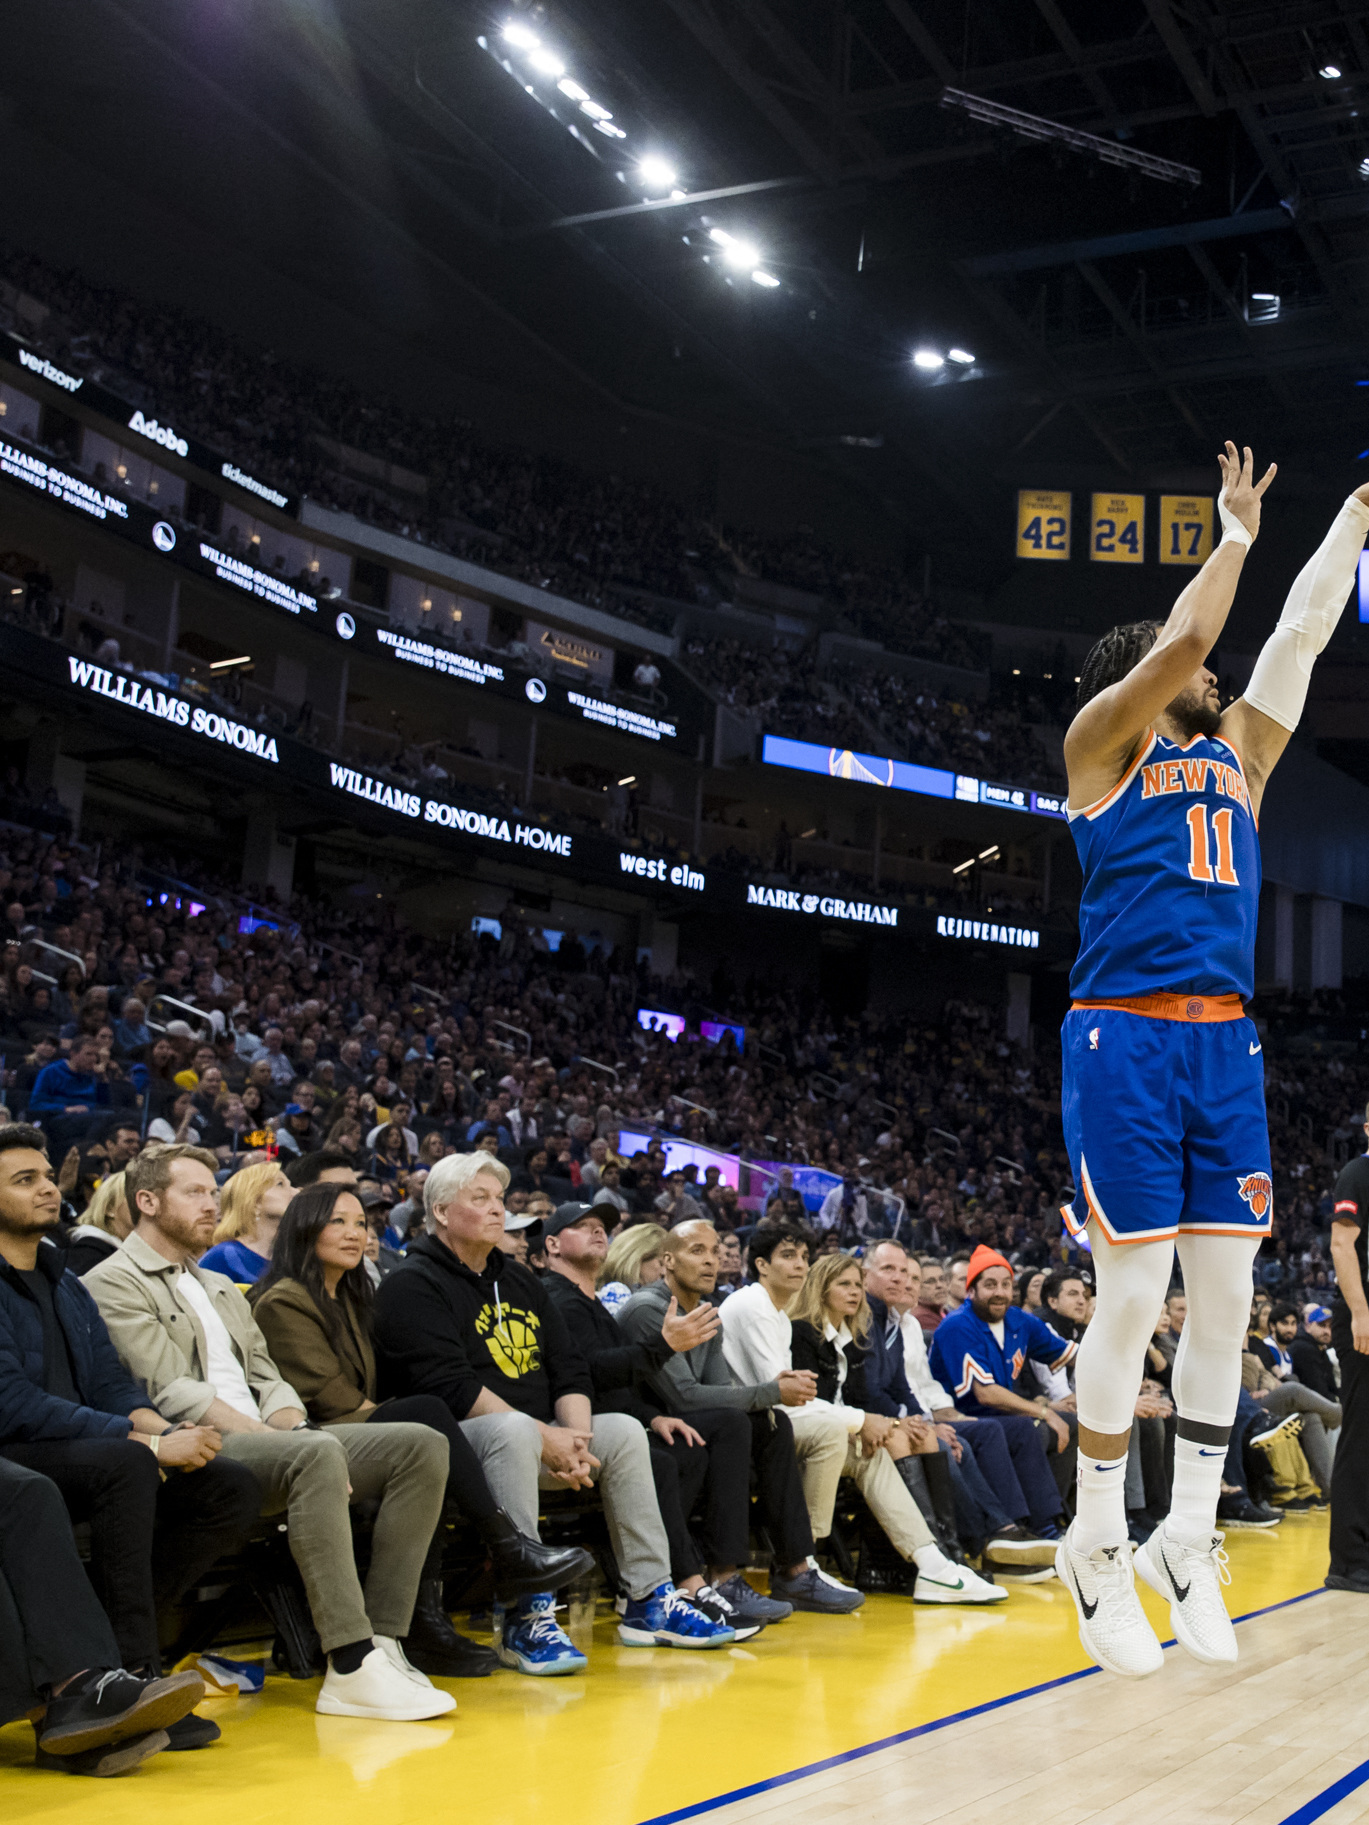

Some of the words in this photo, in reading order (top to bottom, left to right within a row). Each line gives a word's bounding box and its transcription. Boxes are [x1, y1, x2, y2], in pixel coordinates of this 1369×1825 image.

[19, 349, 79, 392] verizon
[128, 411, 188, 457] Adobe
[221, 462, 288, 508] ticketmaster
[1022, 516, 1066, 551] 42
[1095, 519, 1139, 554] 24
[1170, 522, 1204, 556] 17
[68, 656, 190, 727] WILLIAMS
[191, 708, 279, 764] SONOMA
[1141, 758, 1210, 800] NEW
[330, 763, 421, 818] WILLIAMS
[424, 801, 511, 843] SONOMA
[516, 824, 572, 857] HOME
[1187, 803, 1240, 886] 11
[619, 852, 667, 882] west
[670, 863, 705, 891] elm
[747, 885, 800, 911] MARK
[800, 895, 820, 914] &
[820, 897, 898, 926] GRAHAM
[936, 915, 1039, 948] REJUVENATION
